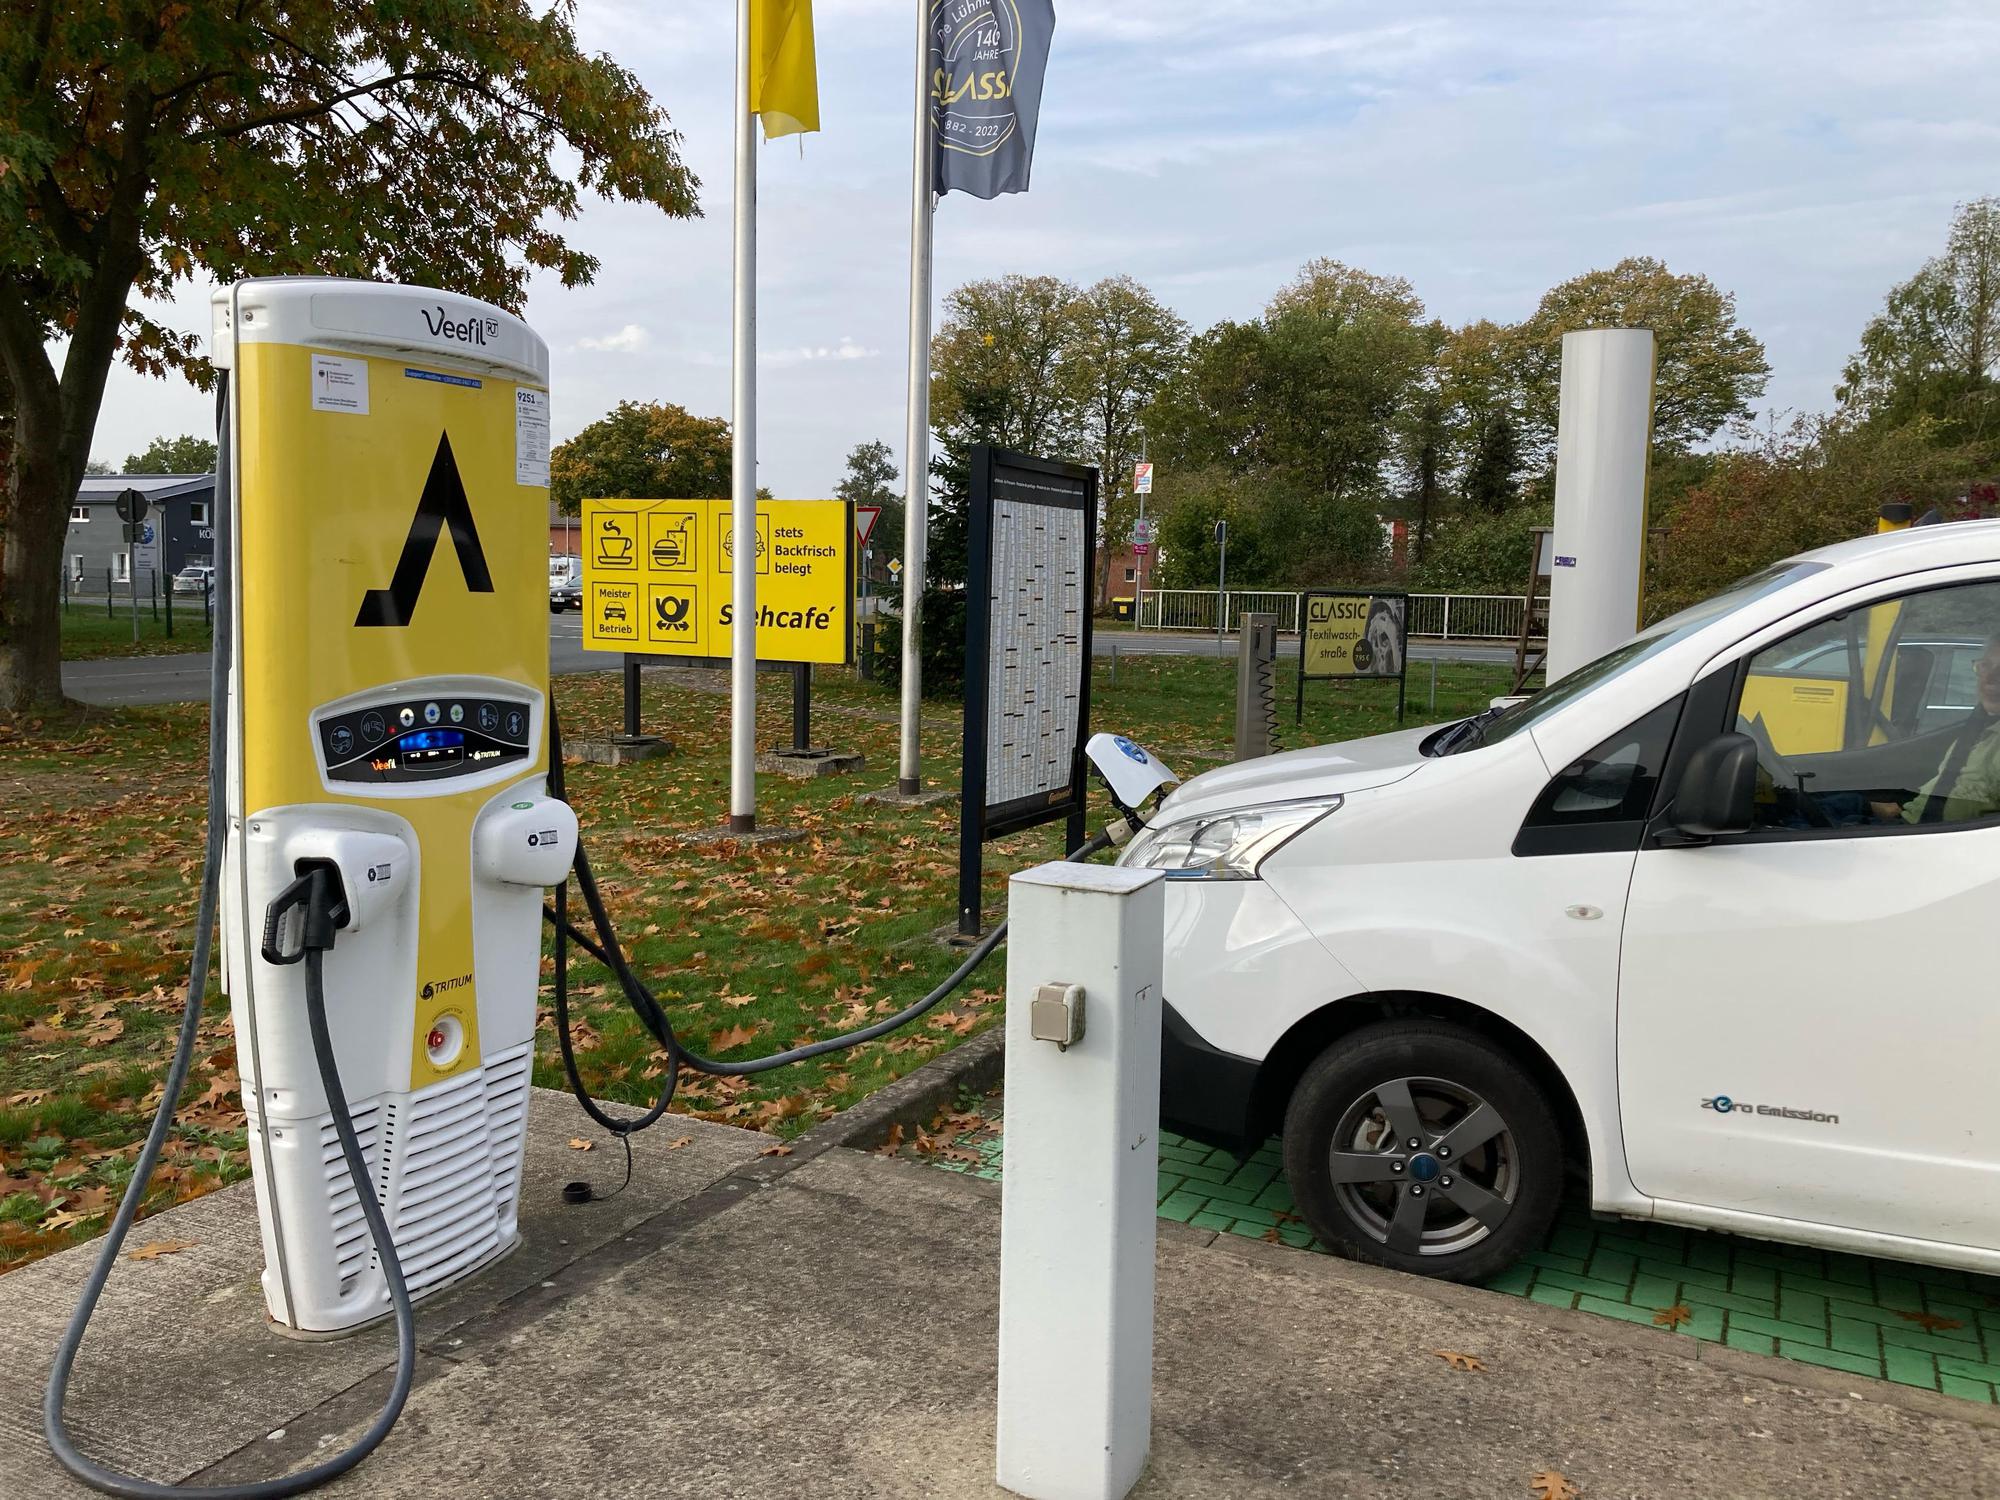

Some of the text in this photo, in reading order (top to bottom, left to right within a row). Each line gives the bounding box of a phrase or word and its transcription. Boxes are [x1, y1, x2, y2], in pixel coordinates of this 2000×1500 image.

[973, 49, 999, 61] JAHRE
[975, 125, 999, 136] 2022
[421, 306, 486, 345] Veefil
[517, 391, 536, 404] 9251
[774, 527, 804, 538] stets
[774, 545, 836, 557] Backfrisch
[774, 562, 812, 577] belegt
[599, 589, 631, 598] Meister
[719, 603, 836, 630] Shcafé
[1309, 601, 1366, 622] CLASSIC
[599, 624, 632, 633] Betrieb
[1308, 627, 1360, 640] Textilwasch-
[1320, 646, 1347, 658] straße
[370, 758, 397, 770] Veefil
[435, 974, 473, 994] TRITIUM
[1756, 1103, 1840, 1124] Emission
